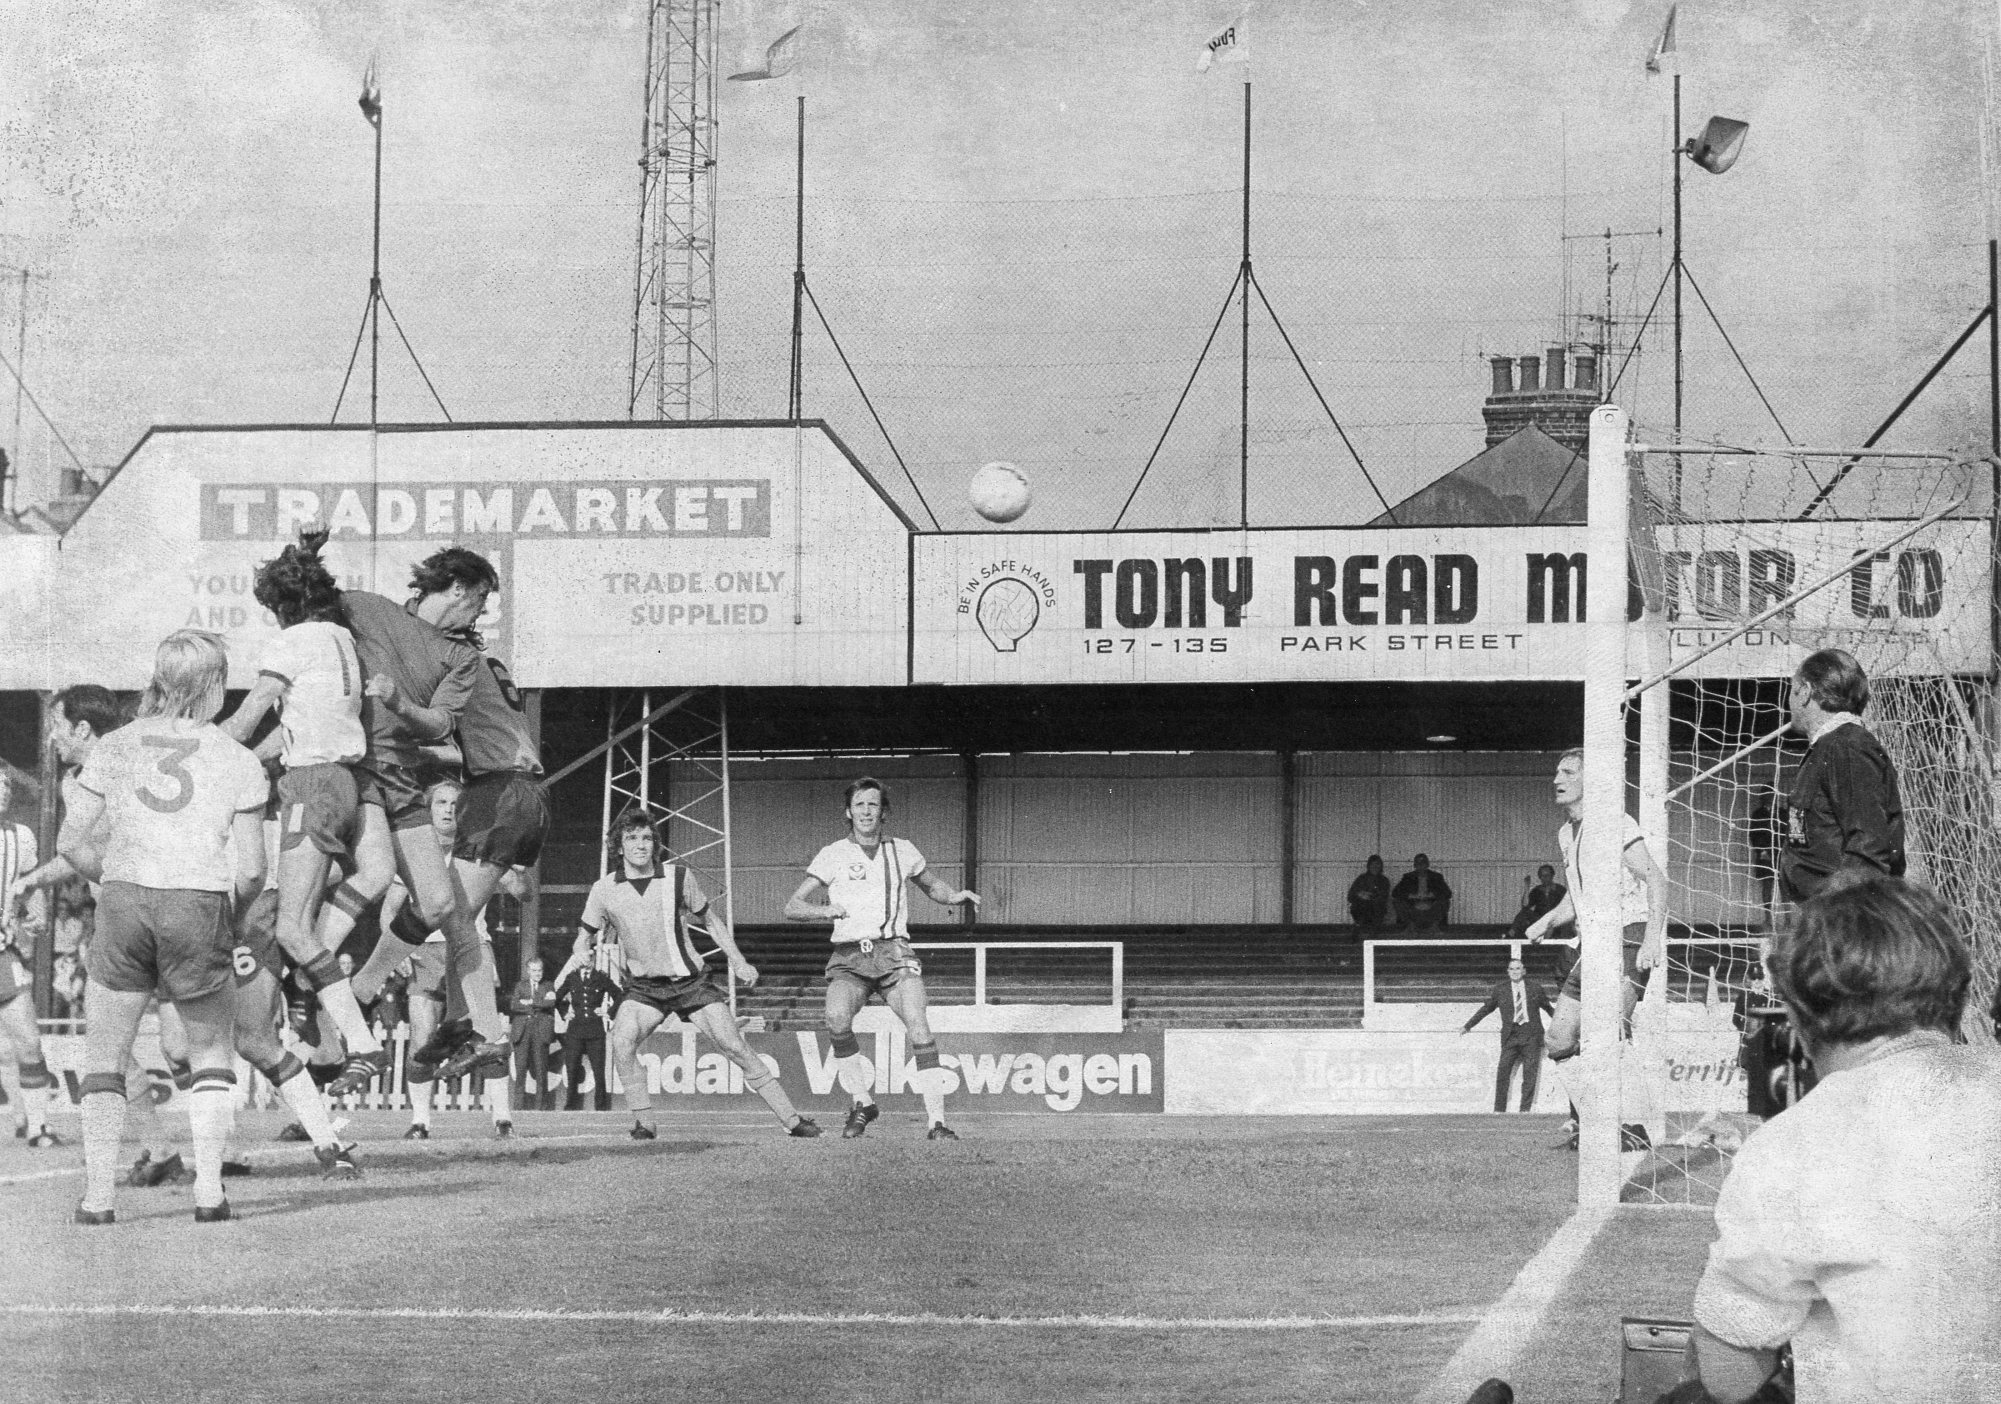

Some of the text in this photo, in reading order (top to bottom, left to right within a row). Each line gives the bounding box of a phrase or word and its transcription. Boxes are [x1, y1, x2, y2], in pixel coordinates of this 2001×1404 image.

[218, 486, 758, 535] TRADEMARKET
[188, 574, 248, 595] YOU
[602, 570, 786, 596] TRADE ONLY
[957, 560, 1056, 614] BE IN SAFE HANDS
[1294, 553, 1478, 626] READ
[184, 606, 248, 628] AND
[630, 603, 770, 627] SUPPLIED
[1281, 635, 1366, 652] PARK
[1388, 634, 1523, 651] STREET
[134, 734, 200, 814] 3
[232, 945, 256, 975] 6
